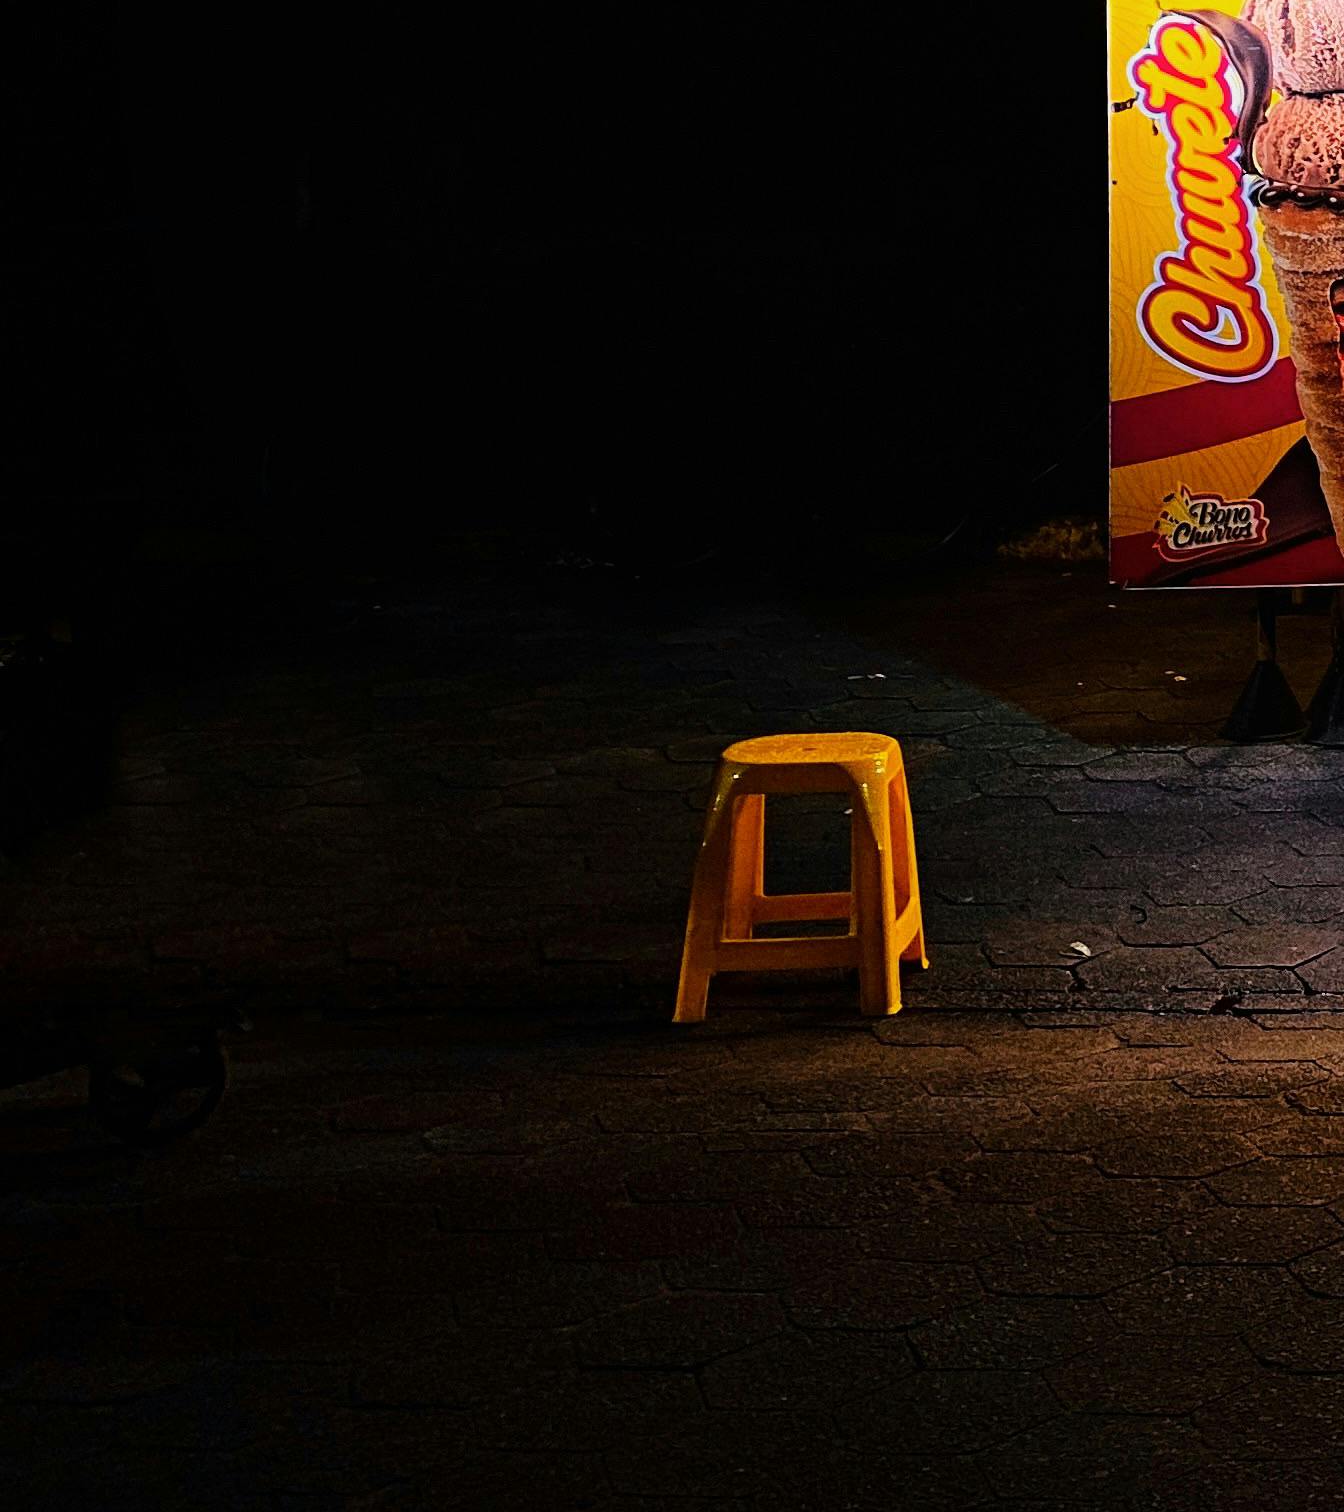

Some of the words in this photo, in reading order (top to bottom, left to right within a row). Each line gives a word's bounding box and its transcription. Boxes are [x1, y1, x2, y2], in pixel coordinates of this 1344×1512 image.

[1133, 21, 1272, 378] Chuvete
[1189, 502, 1251, 525] Bono
[1173, 521, 1253, 548] Churros
